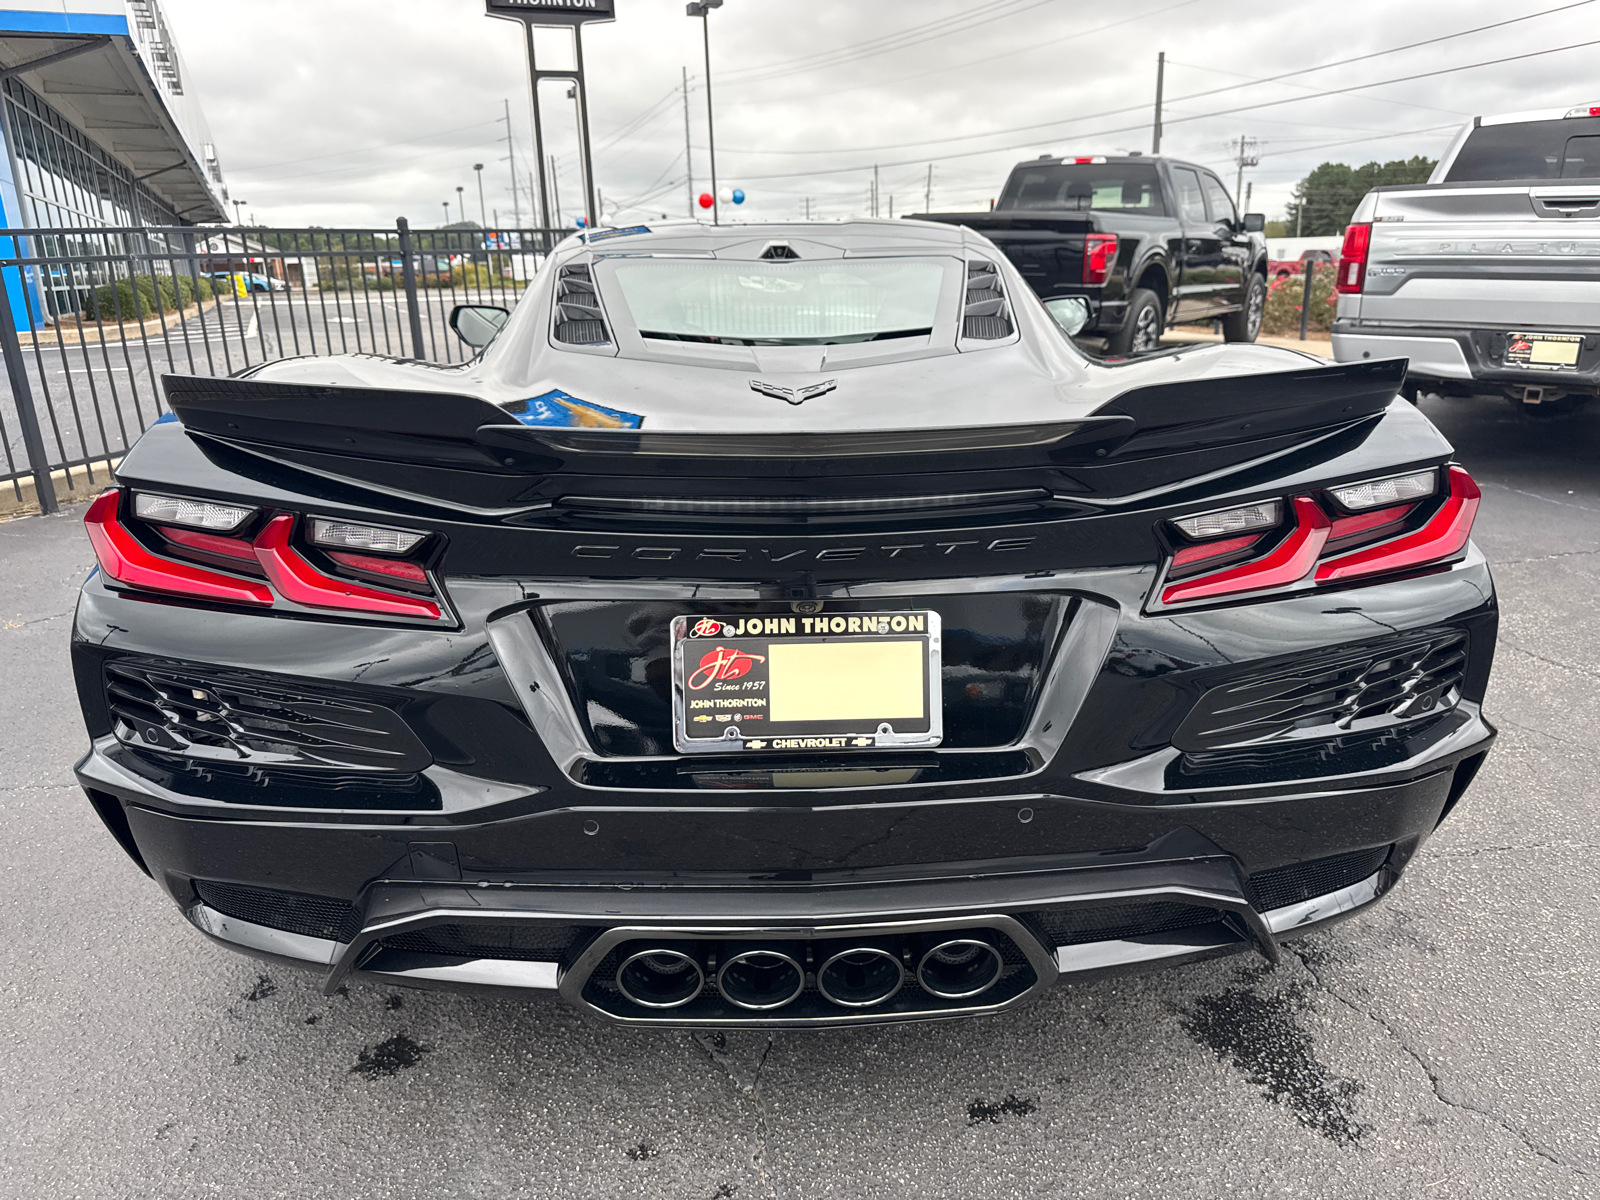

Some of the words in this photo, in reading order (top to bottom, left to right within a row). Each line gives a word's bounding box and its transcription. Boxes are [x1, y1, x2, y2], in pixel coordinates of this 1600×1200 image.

[570, 536, 1037, 562] CORVETTE
[735, 617, 796, 636] JOHN
[801, 615, 924, 634] THORNTON
[713, 681, 740, 692] Since
[742, 680, 766, 690] 1957
[689, 699, 714, 709] JOHN
[714, 697, 767, 708] THORNTON
[771, 737, 848, 749] CHEVROLET
